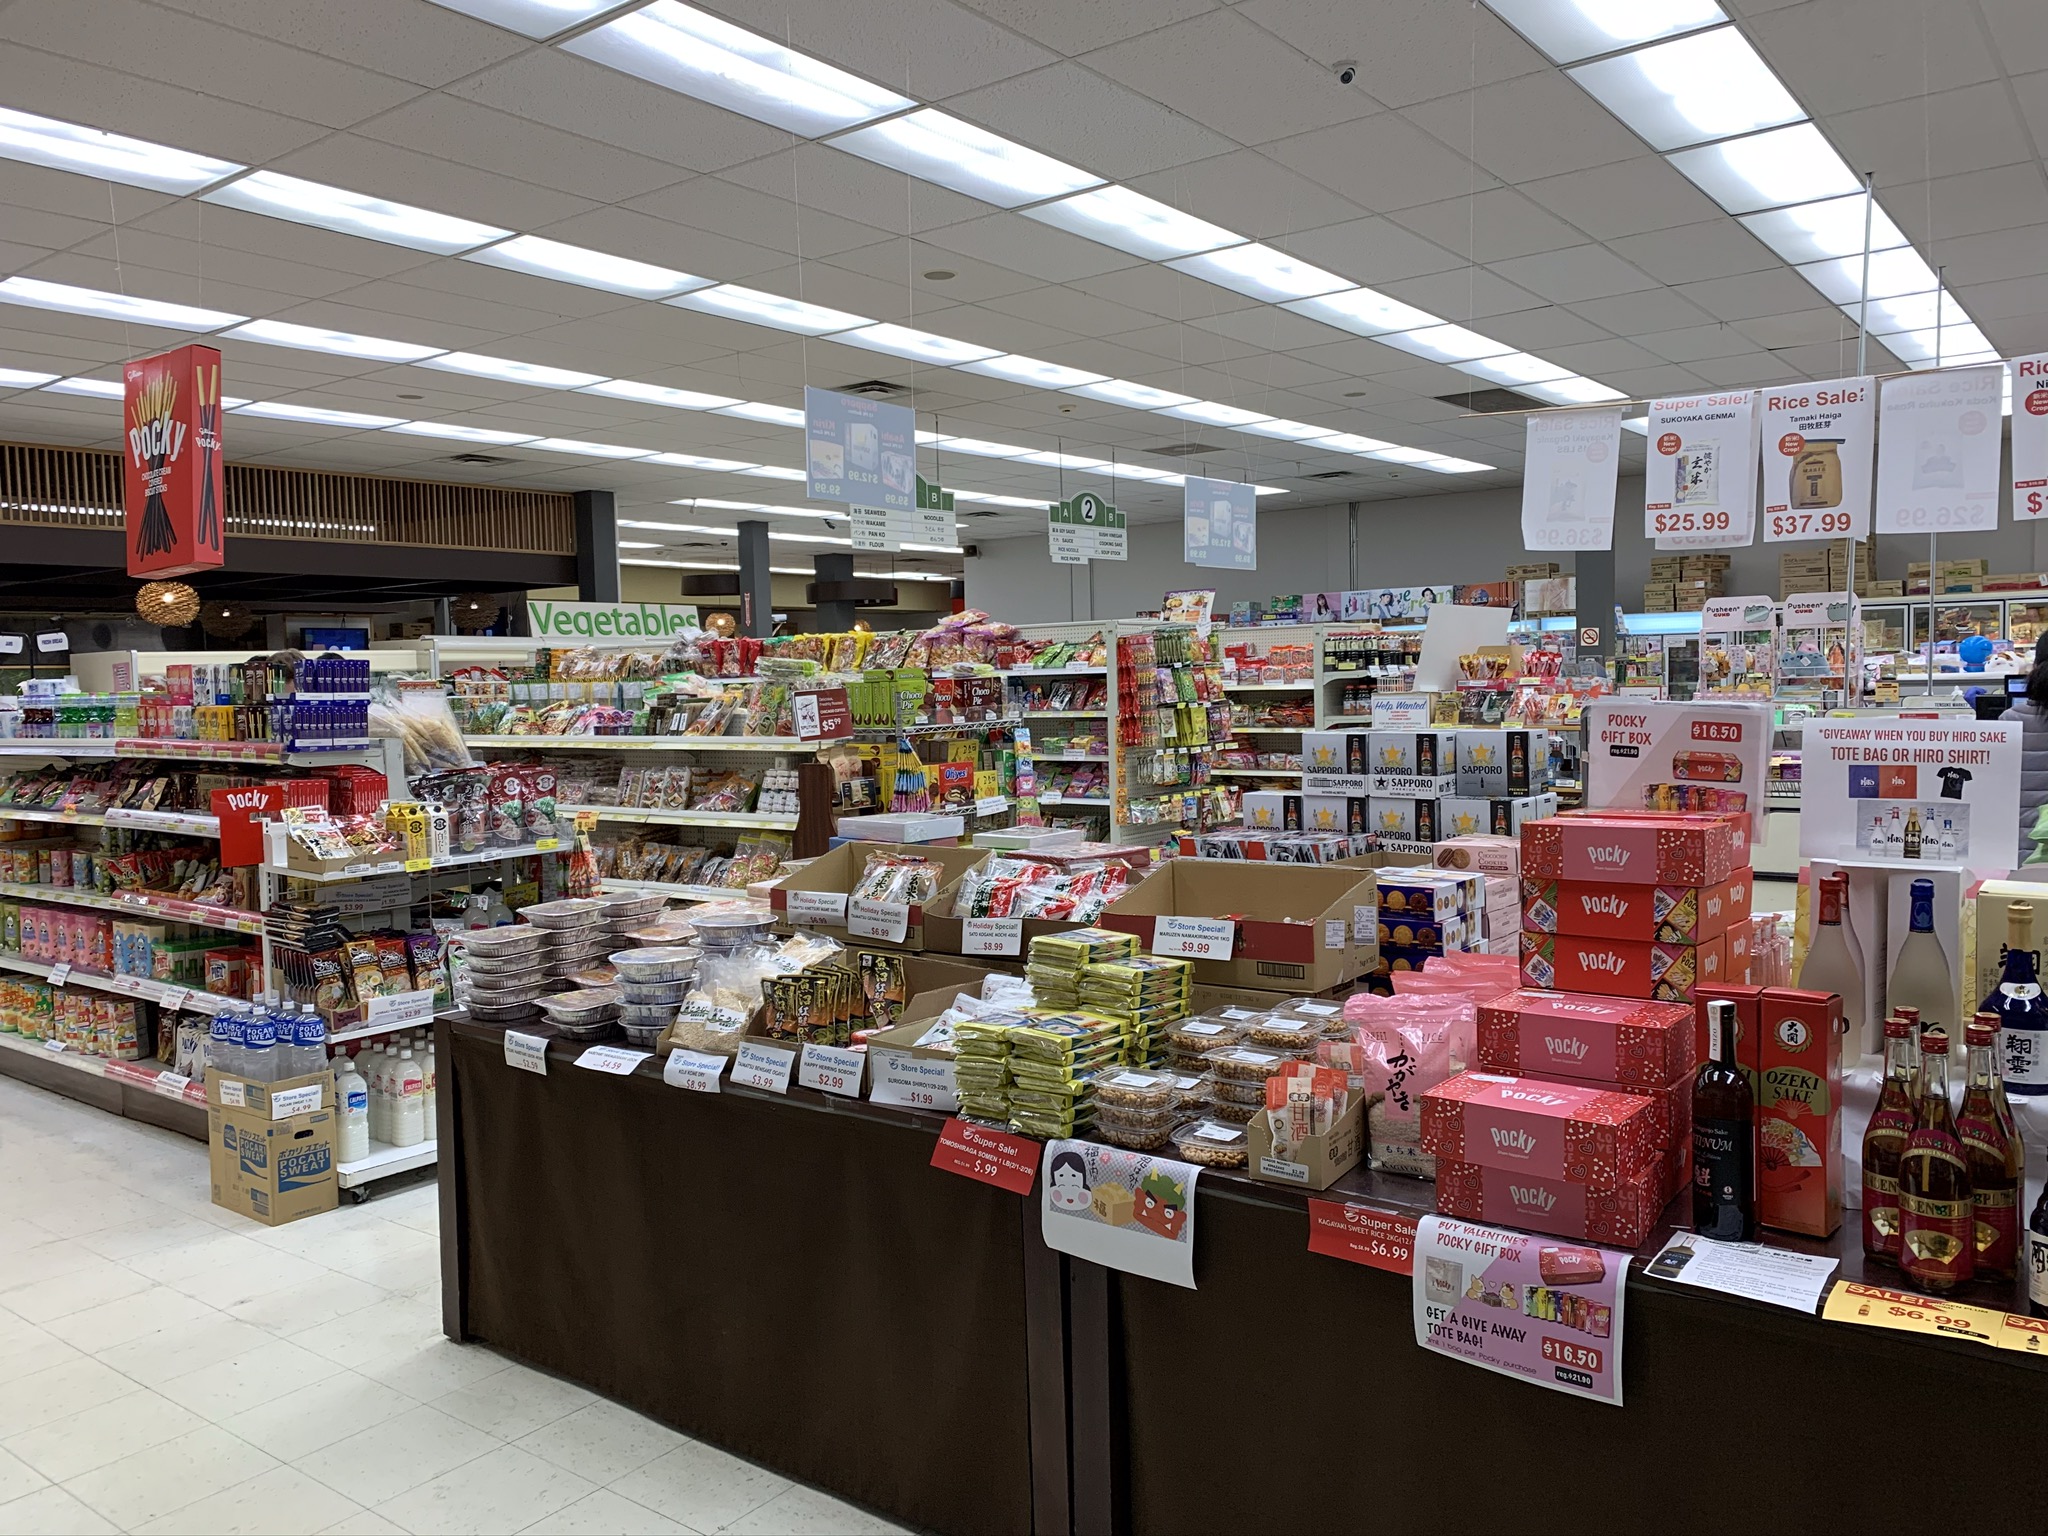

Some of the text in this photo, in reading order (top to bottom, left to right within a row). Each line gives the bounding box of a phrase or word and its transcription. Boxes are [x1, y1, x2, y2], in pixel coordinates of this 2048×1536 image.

[1654, 393, 1749, 411] Super Sale!
[1768, 397, 1810, 412] Rice
[1661, 412, 1736, 425] SUKOYAKA GENMAI
[1789, 412, 1842, 423] Tamaki Haiga
[931, 493, 938, 502] B
[1062, 508, 1069, 518] A
[1084, 499, 1093, 520] 2
[1108, 513, 1114, 522] B
[1655, 511, 1730, 534] $25.99
[1773, 512, 1851, 537] $37.99
[900, 690, 923, 700] Choco
[902, 700, 914, 710] Pie
[1375, 700, 1427, 712] Help Wanted
[1608, 714, 1647, 728] POCKY
[1601, 731, 1652, 746] GIFT BOX
[1692, 724, 1738, 739] $16.50
[1874, 729, 1903, 741] WHEN
[1907, 730, 1926, 742] YOU
[1929, 731, 1949, 742] BUY
[1952, 731, 1976, 743] HIRO
[1980, 731, 2007, 743] SAKE
[1831, 746, 1990, 765] TOTE BAG OR HIRO SHIRT!
[1307, 766, 1343, 774] SAPPORO
[1374, 766, 1412, 775] SAPPORO
[1461, 765, 1502, 775] SAPPORO
[1332, 779, 1363, 788] SAPPORO
[1391, 778, 1433, 789] SAPPORO
[1373, 830, 1411, 840] SAPPORO
[1391, 842, 1432, 854] SAPPORO
[860, 906, 880, 915] Holiday
[871, 927, 890, 937] $6.99
[972, 922, 994, 930] Holiday
[1177, 922, 1226, 934] Store Special!
[983, 942, 1003, 951] $8.99
[1181, 941, 1210, 953] $9.99
[749, 1053, 764, 1062] Store
[816, 1053, 860, 1068] Store Special!
[818, 1064, 837, 1073] HERRING
[901, 1063, 945, 1076] Store Special!
[686, 1079, 706, 1090] $8.99
[752, 1074, 773, 1087] $3.99
[818, 1073, 843, 1088] $2.99
[1765, 1071, 1821, 1091] OZEKI
[911, 1092, 933, 1104] $1.99
[1772, 1088, 1814, 1104] SAKE
[291, 1104, 311, 1114] $4.99
[240, 1139, 267, 1154] POCARI
[940, 1137, 998, 1163] TOMOSHIRAGA SOMEN
[973, 1134, 1018, 1157] Super Sale!
[240, 1149, 265, 1164] SWEAT
[279, 1150, 330, 1170] POCARI
[279, 1159, 326, 1178] SWEAT
[974, 1159, 997, 1176] $.99
[1318, 1218, 1385, 1239] KAGAYAKI SWEET RICE
[1360, 1215, 1417, 1236] Super Sale
[1438, 1221, 1529, 1247] BUY VALENTINE'S
[1371, 1239, 1408, 1260] $6.99
[1437, 1233, 1521, 1263] POCKY GIFT BOX
[1847, 1284, 1924, 1306] SALE!
[1887, 1306, 1971, 1329] $6.99
[1426, 1306, 1527, 1344] GET A GIVE AWAY
[1427, 1322, 1454, 1340] TOTE
[1456, 1329, 1483, 1348] BAG!
[1543, 1340, 1598, 1369] $16.50
[1478, 1352, 1501, 1365] Pocky
[1503, 1360, 1537, 1375] purchase
